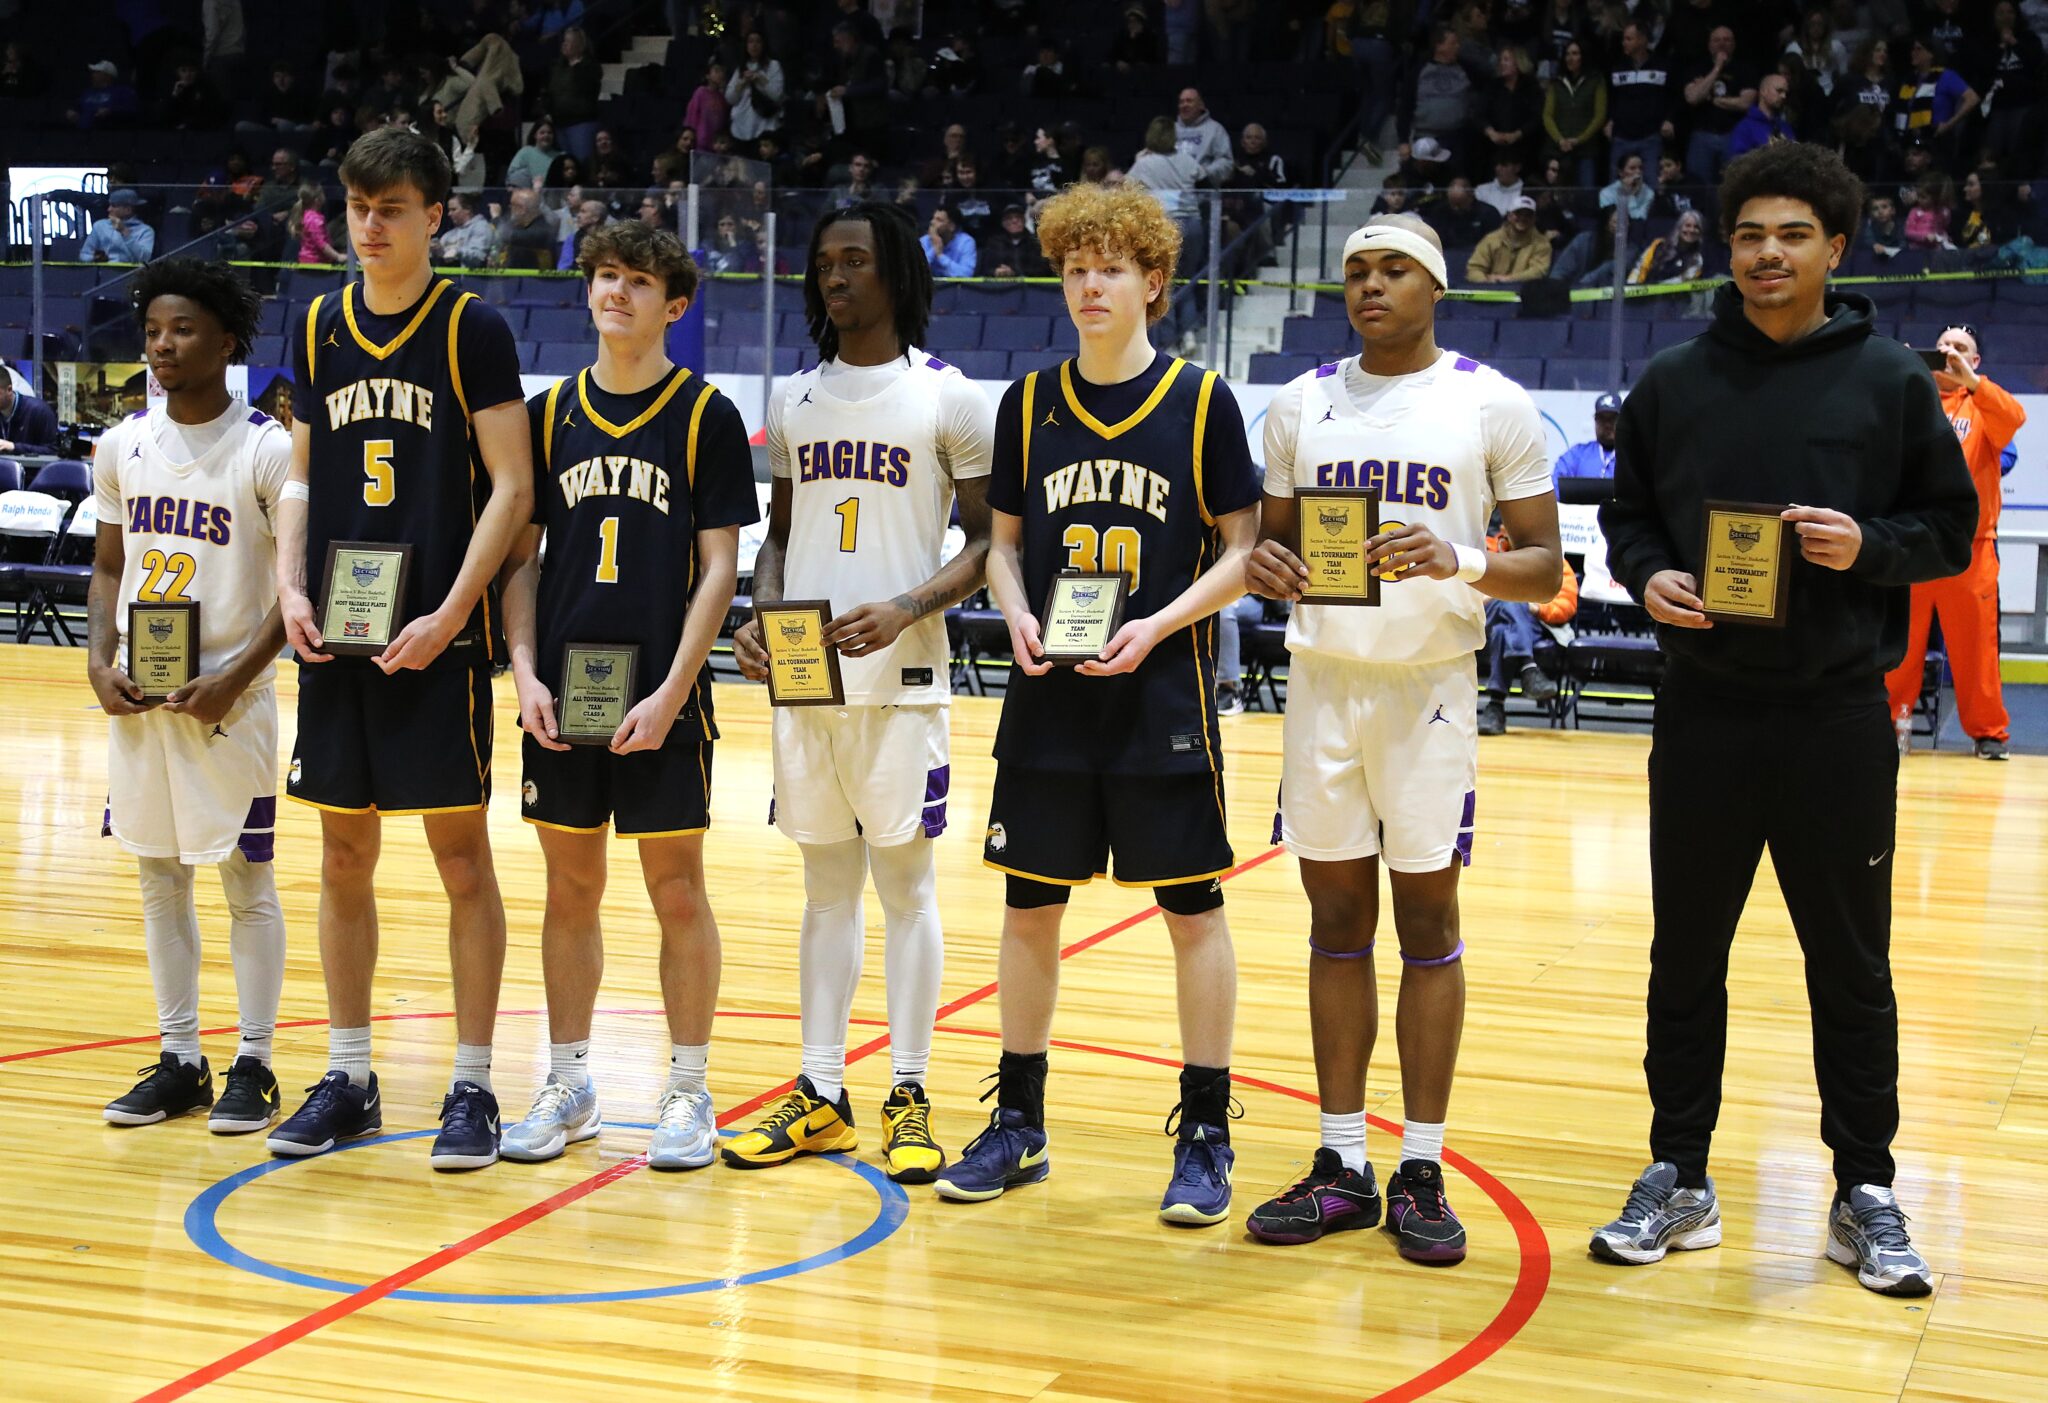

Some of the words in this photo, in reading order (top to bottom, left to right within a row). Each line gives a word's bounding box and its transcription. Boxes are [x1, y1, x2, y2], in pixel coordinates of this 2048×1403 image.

[326, 378, 434, 433] WAYNE
[364, 439, 396, 507] 5
[559, 455, 671, 516] WAYNE
[797, 440, 911, 488] EAGLES
[1043, 458, 1171, 524] WAYNE
[1317, 459, 1451, 511] EAGLES
[2, 504, 25, 516] Ralph
[27, 505, 52, 516] Honda
[834, 496, 860, 553] 1
[595, 516, 619, 584] 1
[1061, 523, 1142, 597] 30
[1560, 533, 1587, 543] ction
[1591, 535, 1598, 544] V
[137, 548, 197, 603] 22
[1727, 568, 1768, 577] TOURNAMENT
[924, 672, 931, 681] M
[1193, 738, 1201, 746] XL
